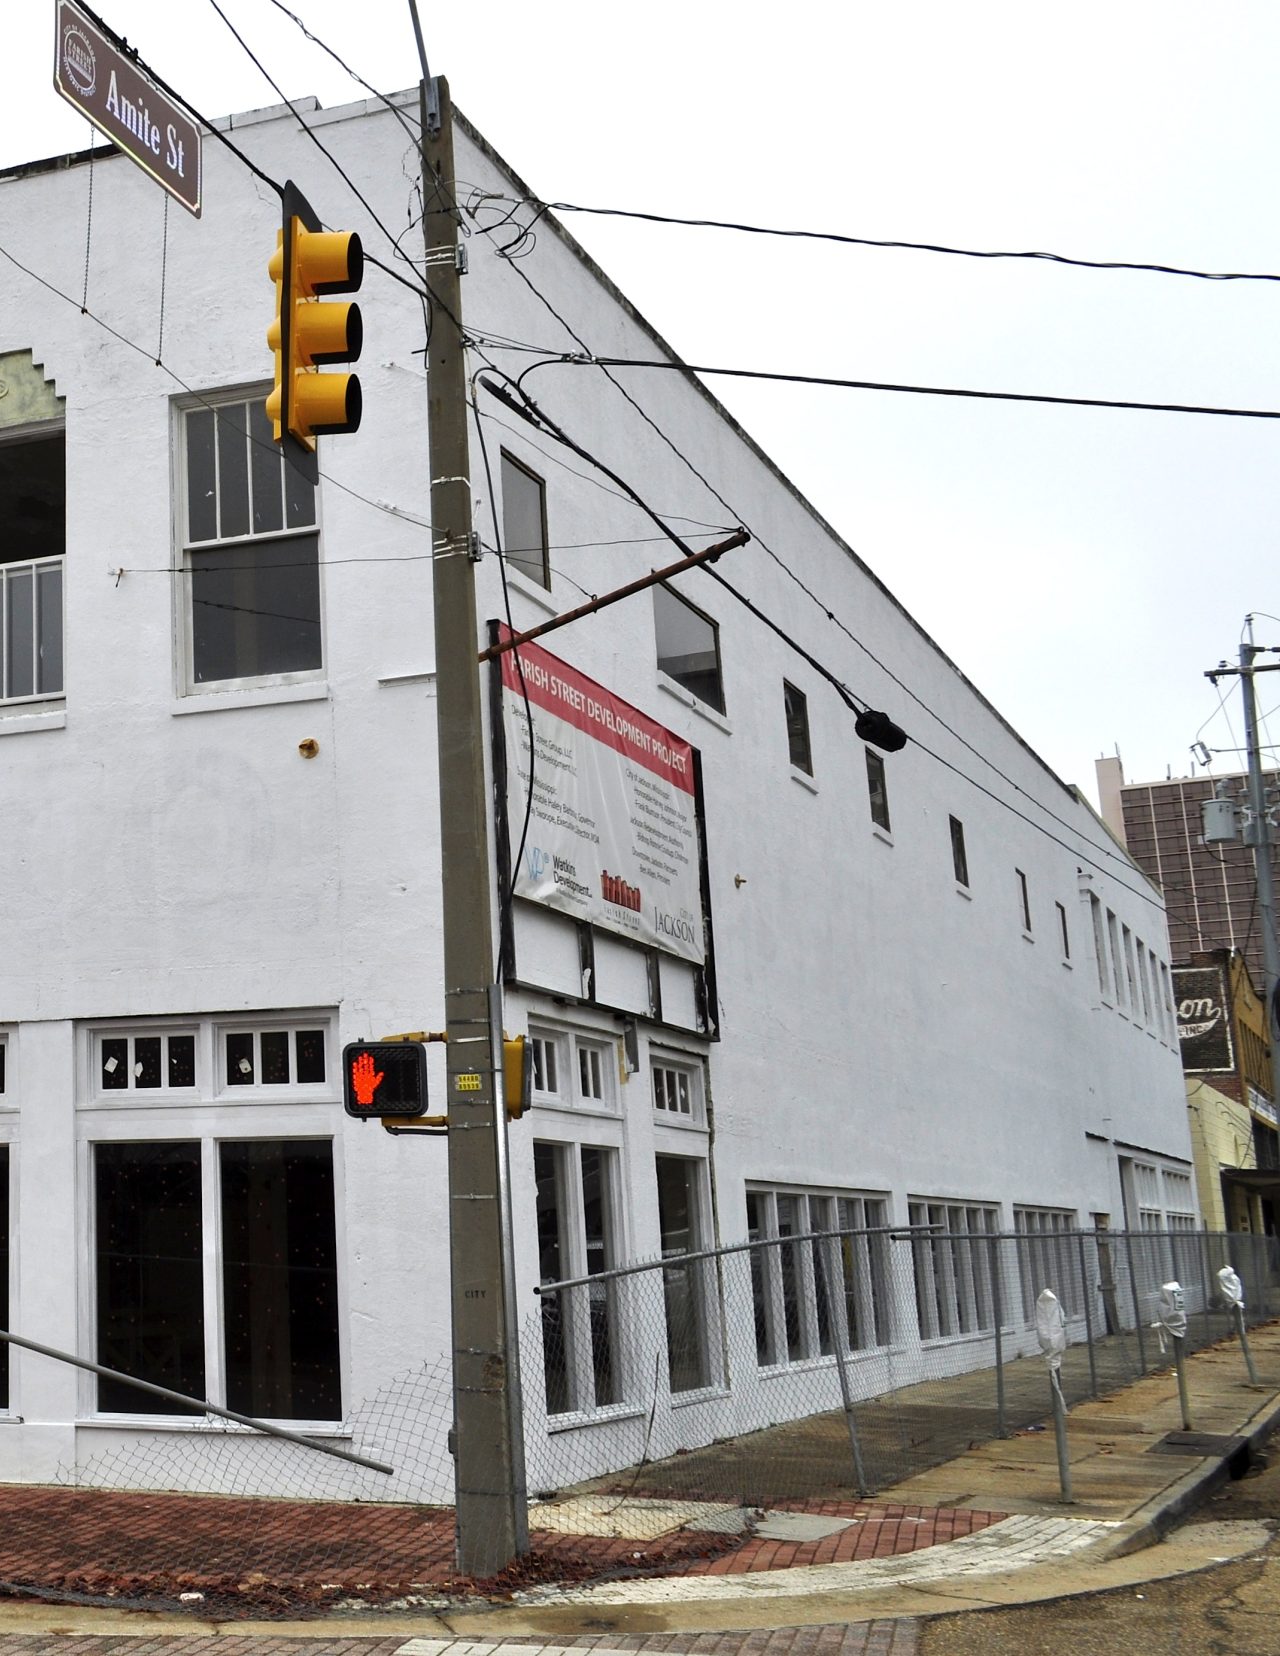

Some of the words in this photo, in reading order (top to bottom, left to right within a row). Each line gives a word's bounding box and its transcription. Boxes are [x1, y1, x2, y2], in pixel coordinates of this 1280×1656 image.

[67, 45, 92, 74] STREET
[68, 38, 92, 66] PARISH
[105, 70, 160, 155] Amite
[166, 123, 185, 178] St
[550, 675, 586, 713] STREET
[587, 697, 652, 753] DEVELOPMENT
[651, 738, 687, 774] PROJECT
[552, 855, 577, 877] Watkins
[654, 906, 696, 944] JACKSON
[464, 1290, 487, 1299] CITY
